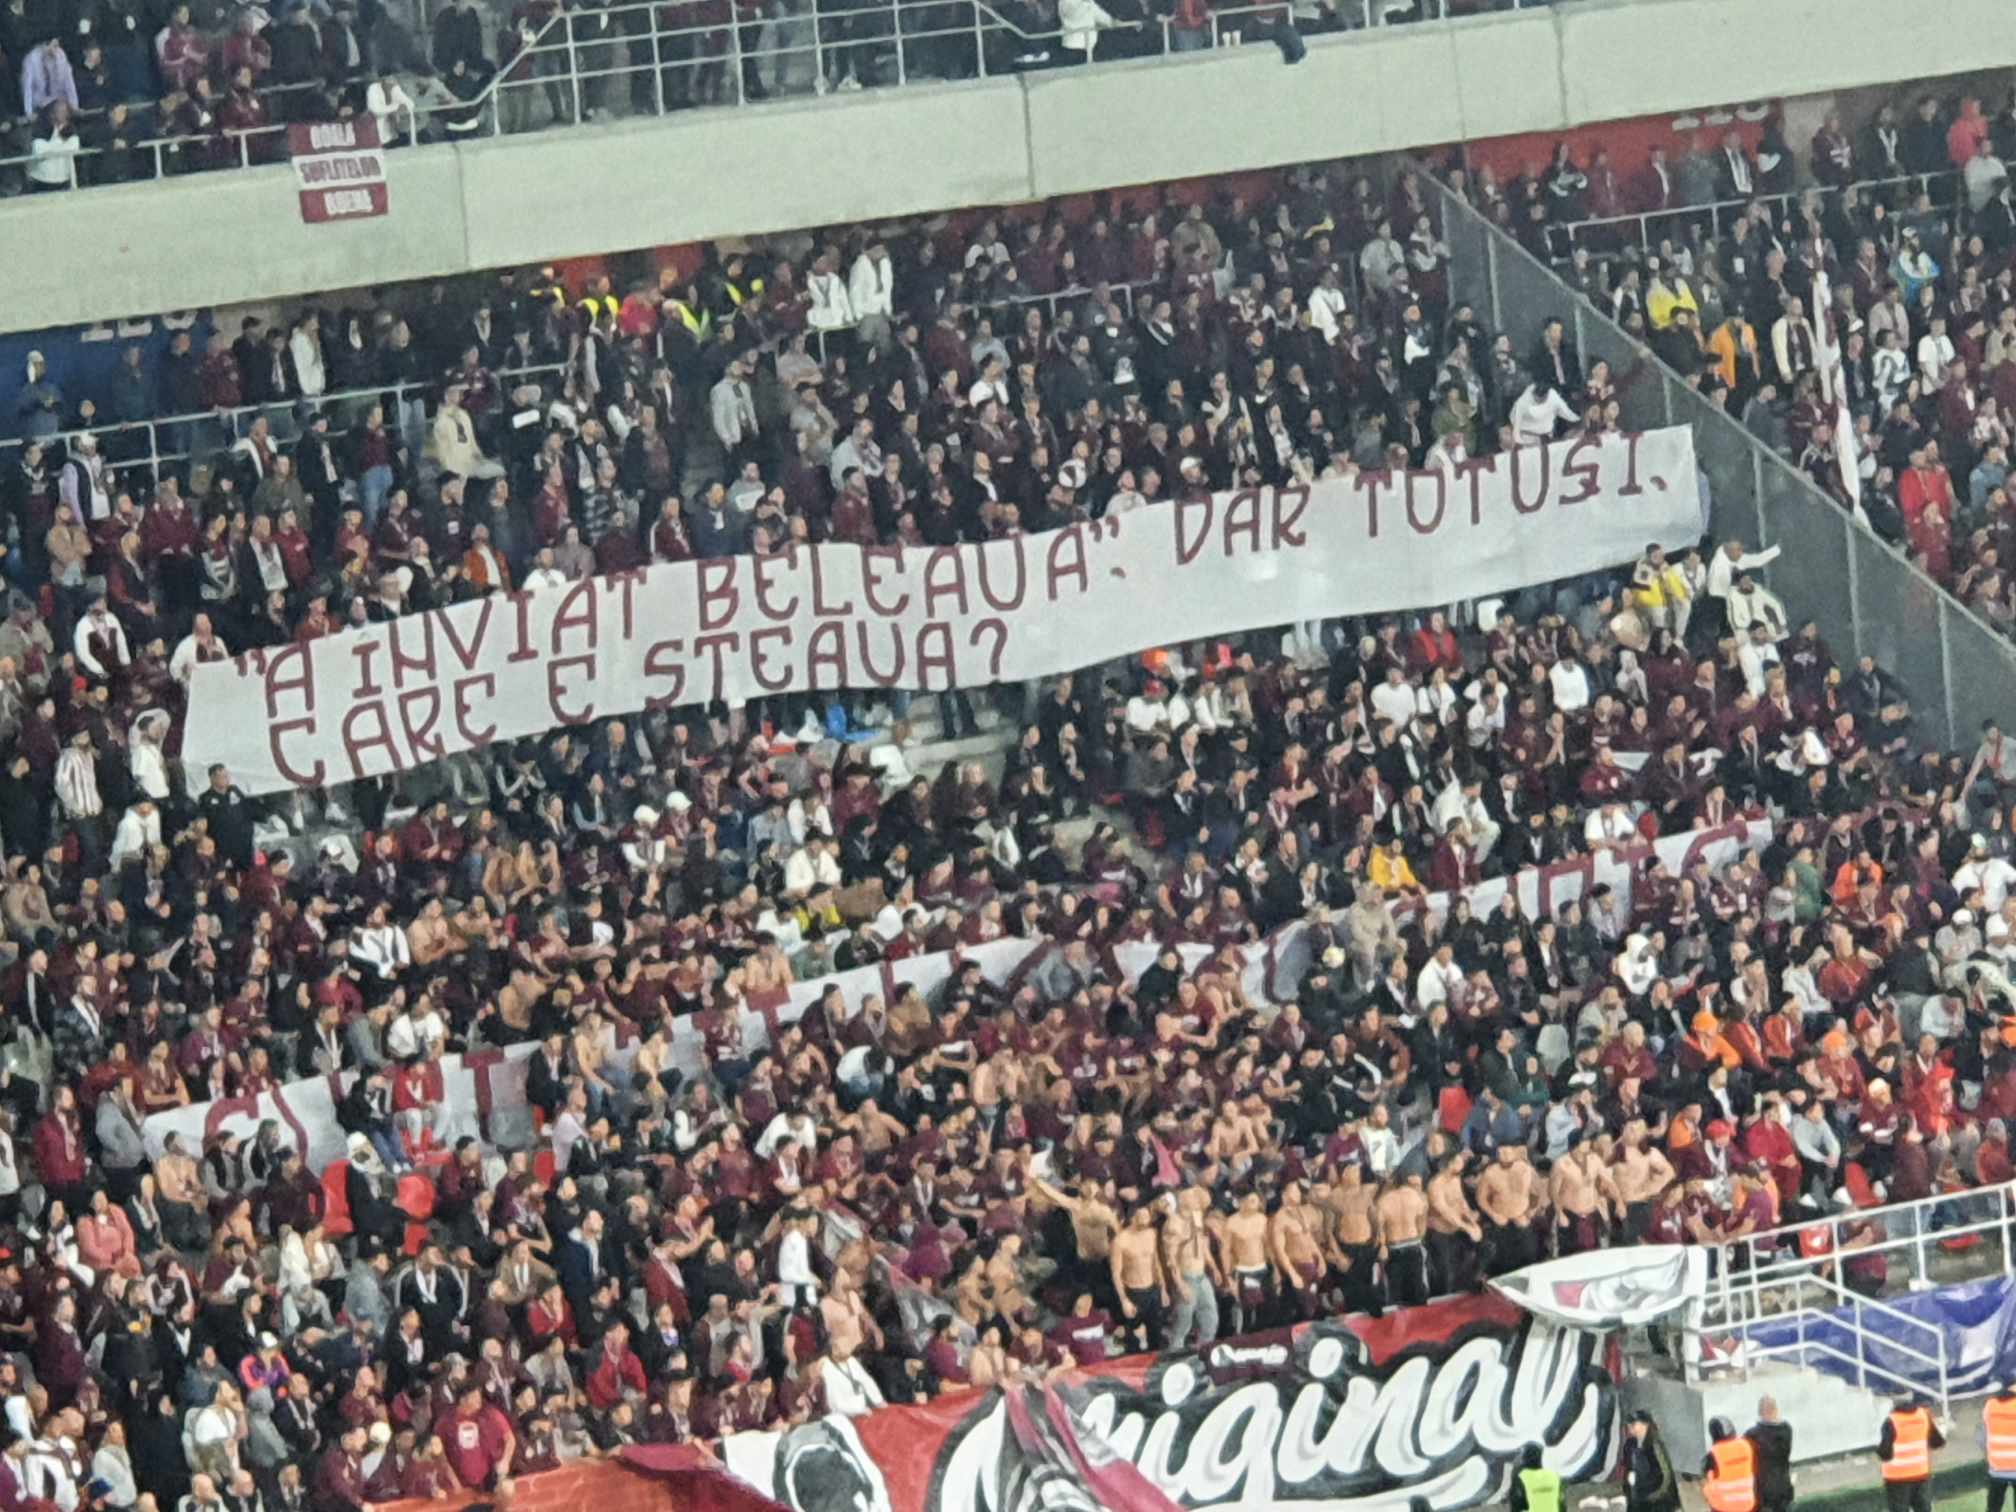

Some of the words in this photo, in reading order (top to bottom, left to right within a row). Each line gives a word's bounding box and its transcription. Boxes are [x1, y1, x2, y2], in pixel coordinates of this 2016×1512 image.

[352, 564, 648, 699] INVIAT
[1174, 484, 1311, 565] DAR
[270, 672, 496, 787] CARE
[547, 653, 596, 725] E
[644, 617, 1008, 712] STEAUA?
